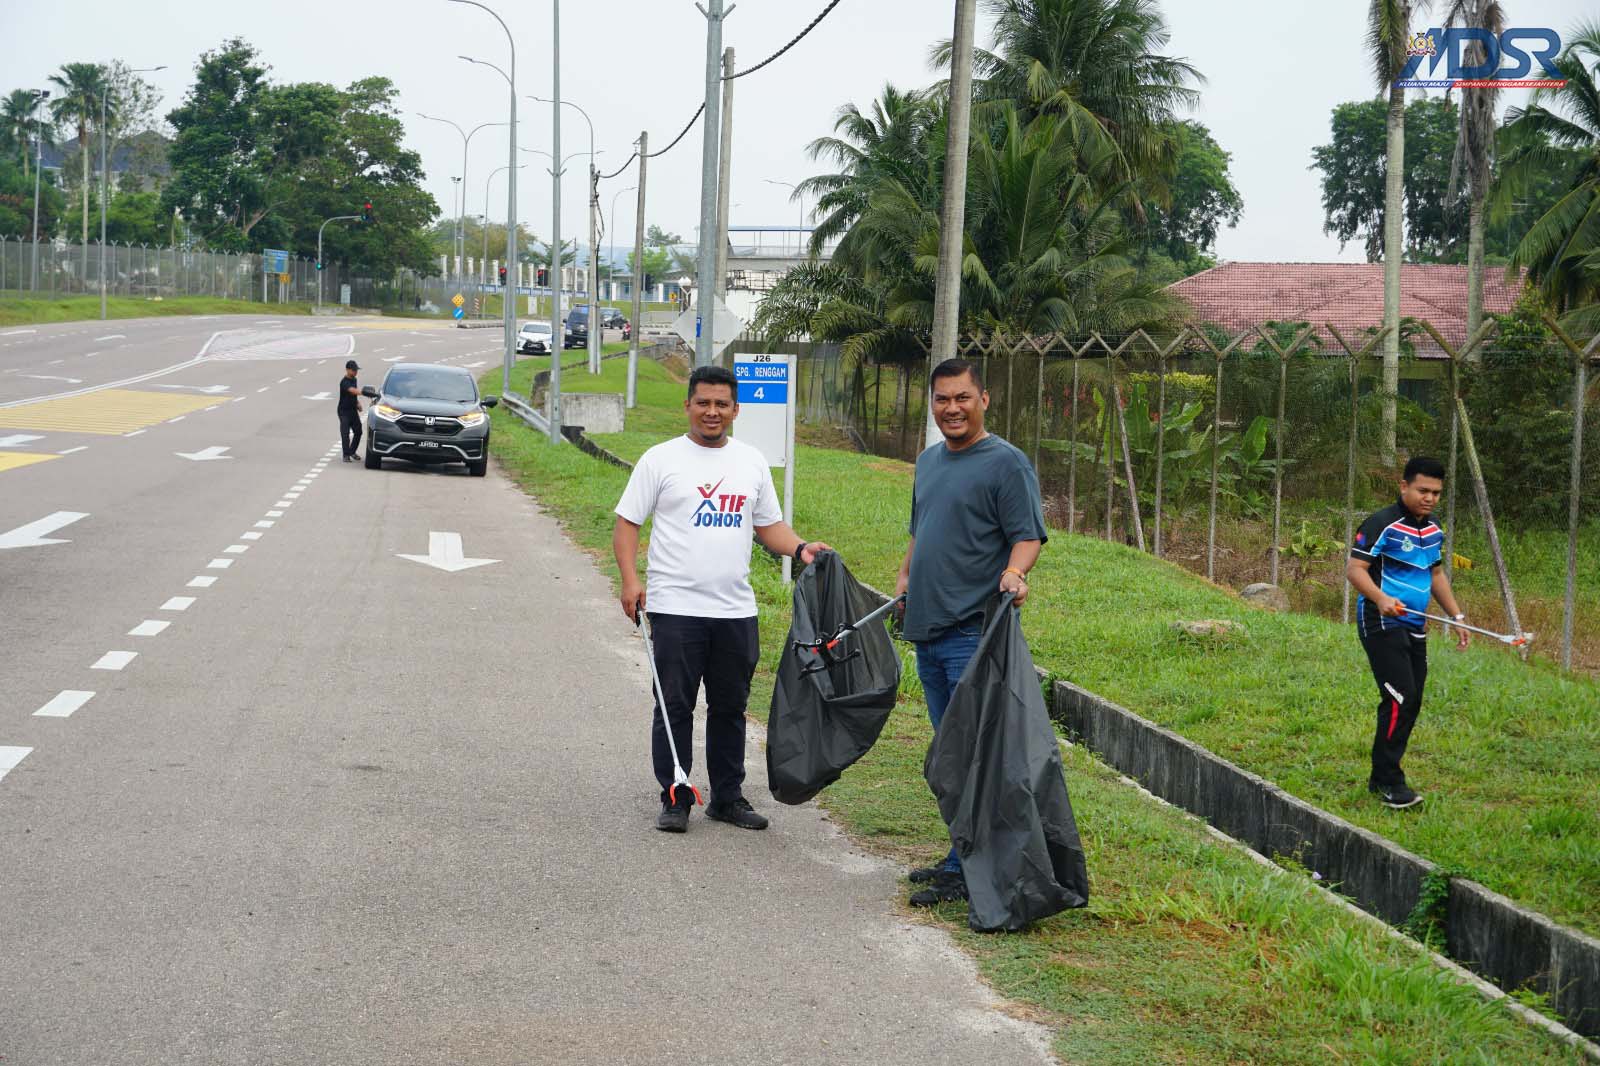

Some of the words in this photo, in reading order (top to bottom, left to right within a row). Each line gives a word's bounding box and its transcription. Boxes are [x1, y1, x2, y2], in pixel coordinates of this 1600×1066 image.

[736, 366, 751, 377] SPG.
[754, 366, 786, 378] RENGGAM
[753, 386, 765, 400] 4
[693, 512, 743, 528] JOHOR
